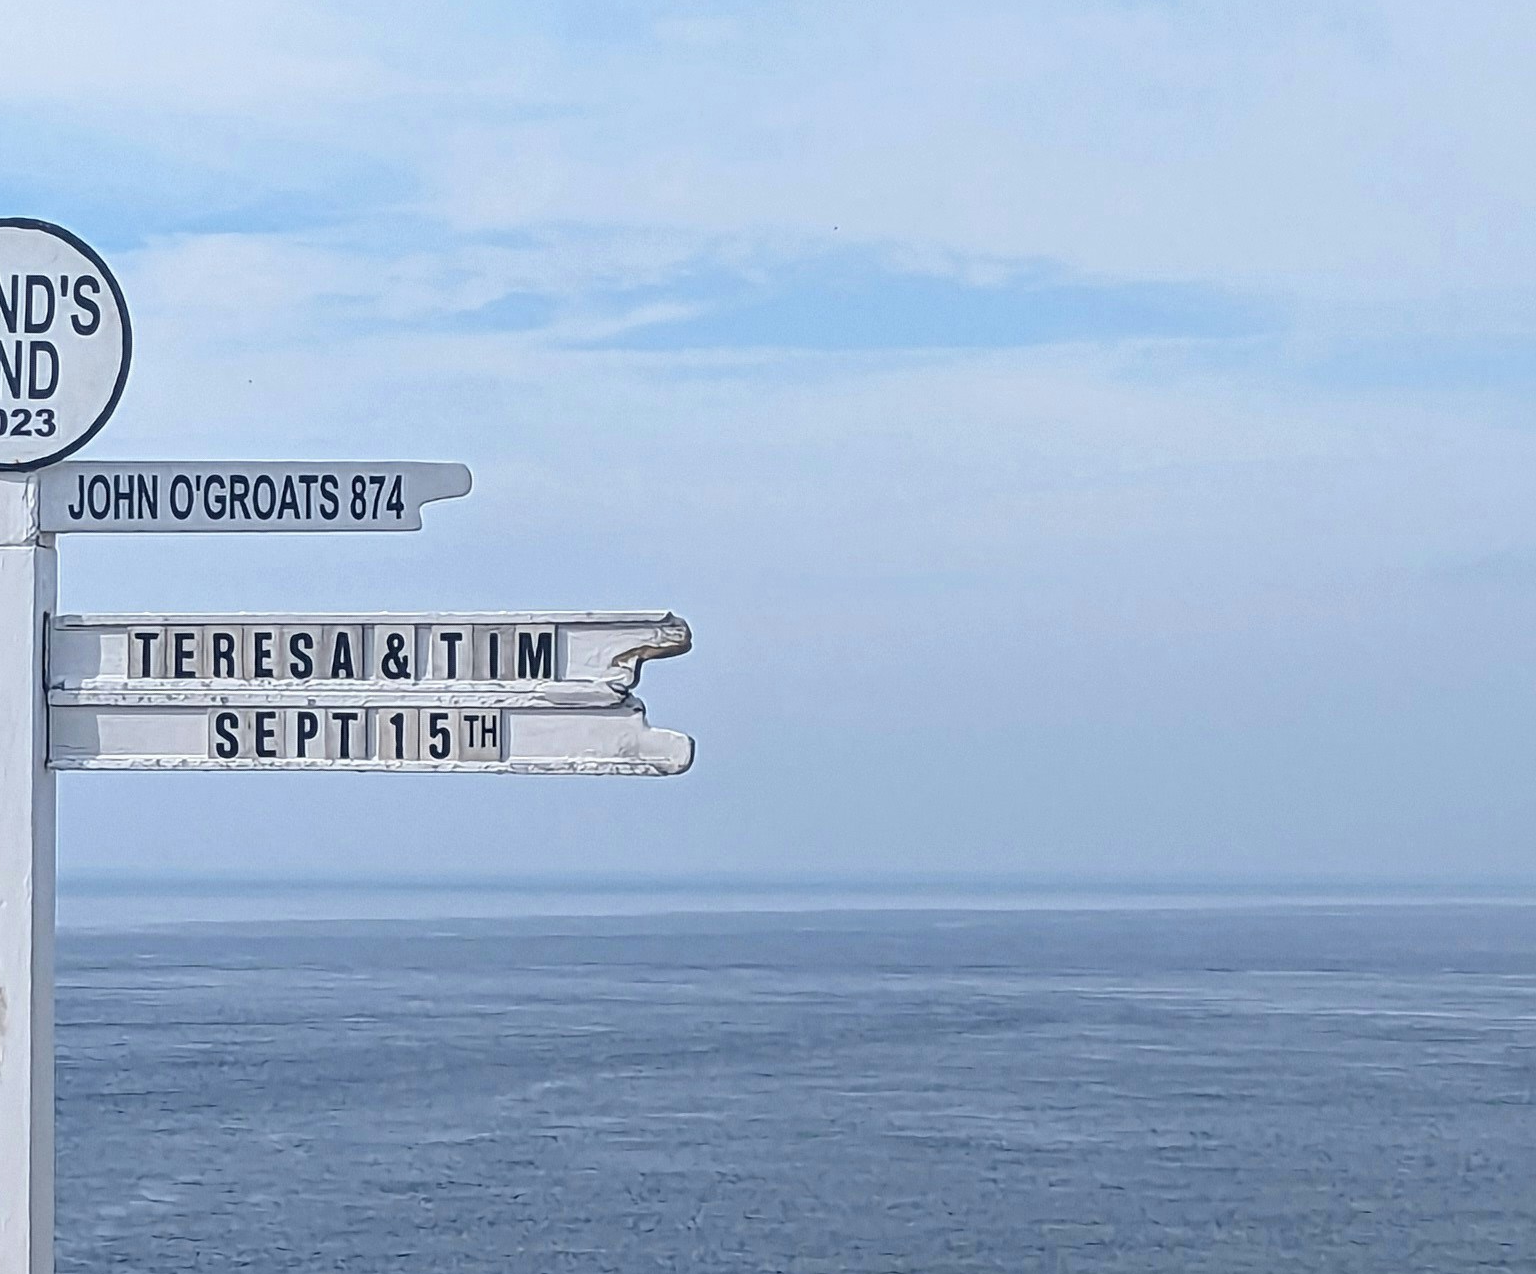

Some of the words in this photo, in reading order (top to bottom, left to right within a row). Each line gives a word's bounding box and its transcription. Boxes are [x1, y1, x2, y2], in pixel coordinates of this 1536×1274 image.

[67, 474, 159, 520] JOHN
[169, 473, 339, 520] O'GROATS
[349, 475, 404, 520] 874
[134, 632, 356, 680] TERESA
[380, 632, 412, 680] &
[440, 632, 553, 680] TIM
[214, 711, 359, 759] SEPT
